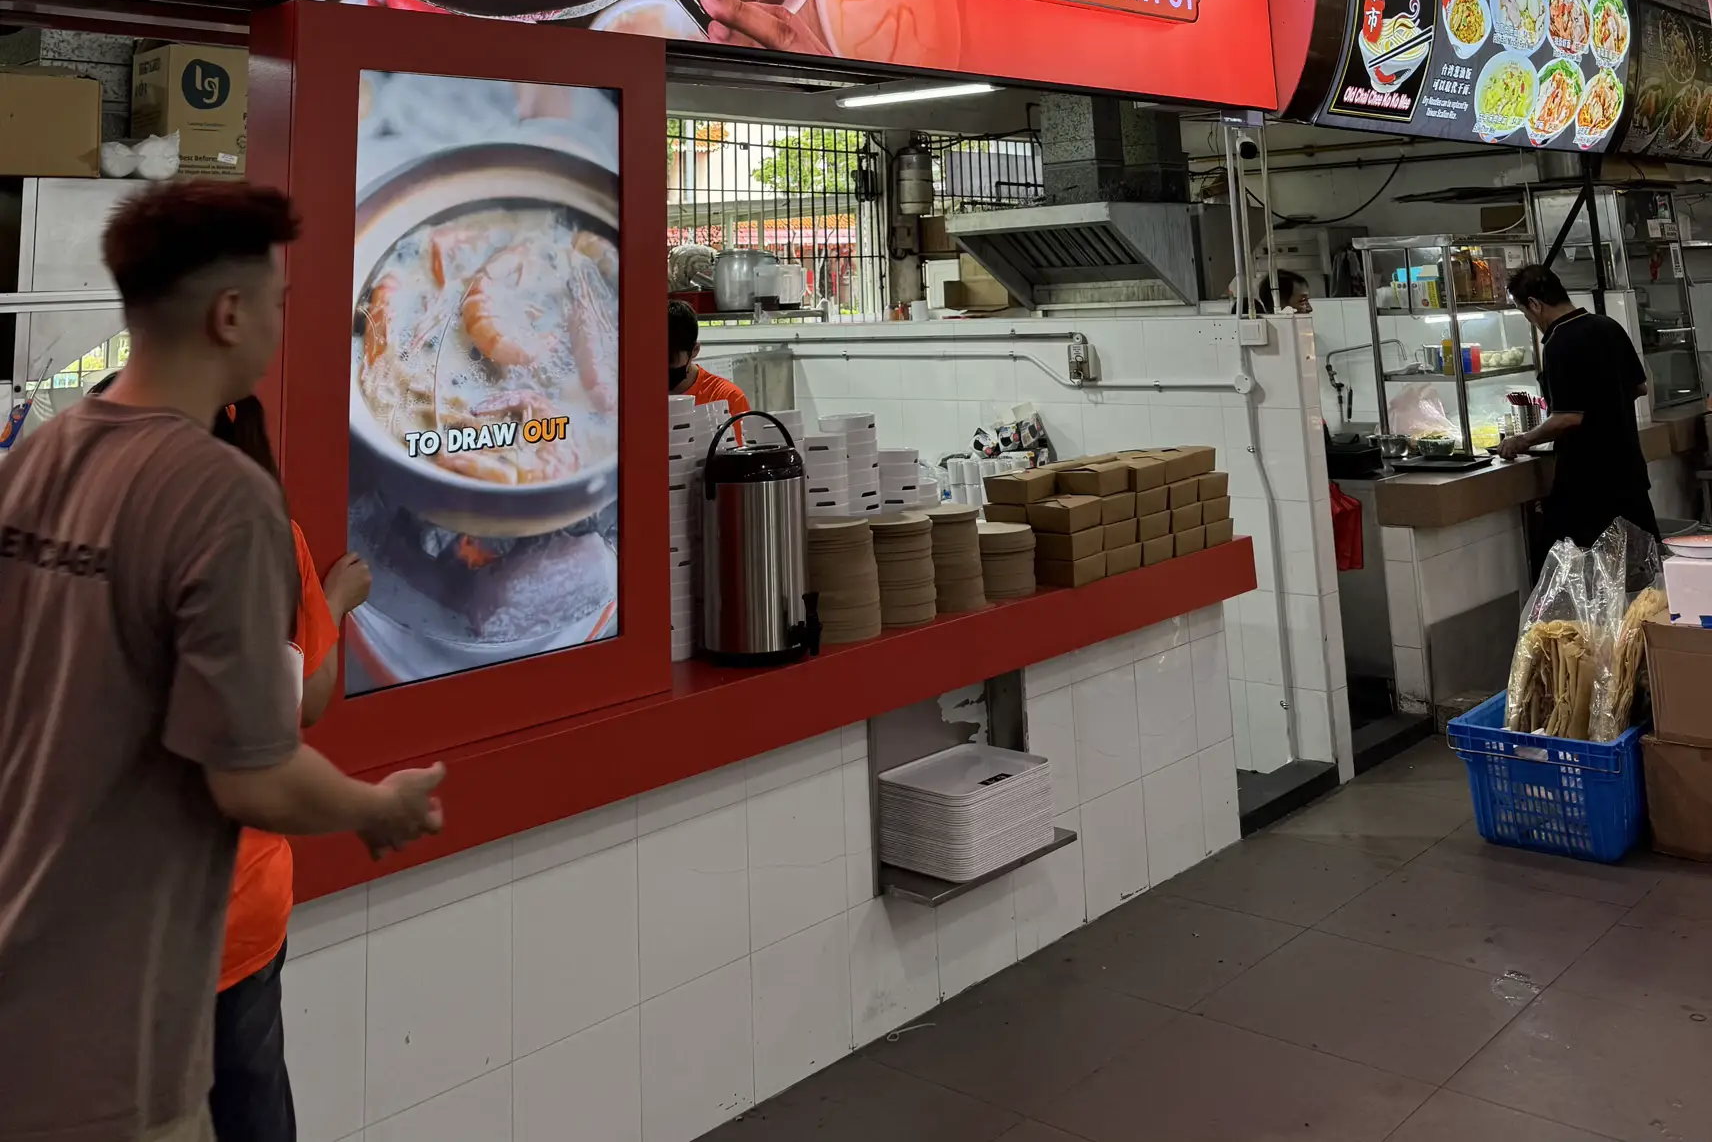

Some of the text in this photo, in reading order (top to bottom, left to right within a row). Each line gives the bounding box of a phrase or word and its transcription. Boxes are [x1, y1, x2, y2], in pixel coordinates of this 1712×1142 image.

[1343, 86, 1357, 103] Old
[405, 416, 570, 457] TO DRAW OUT
